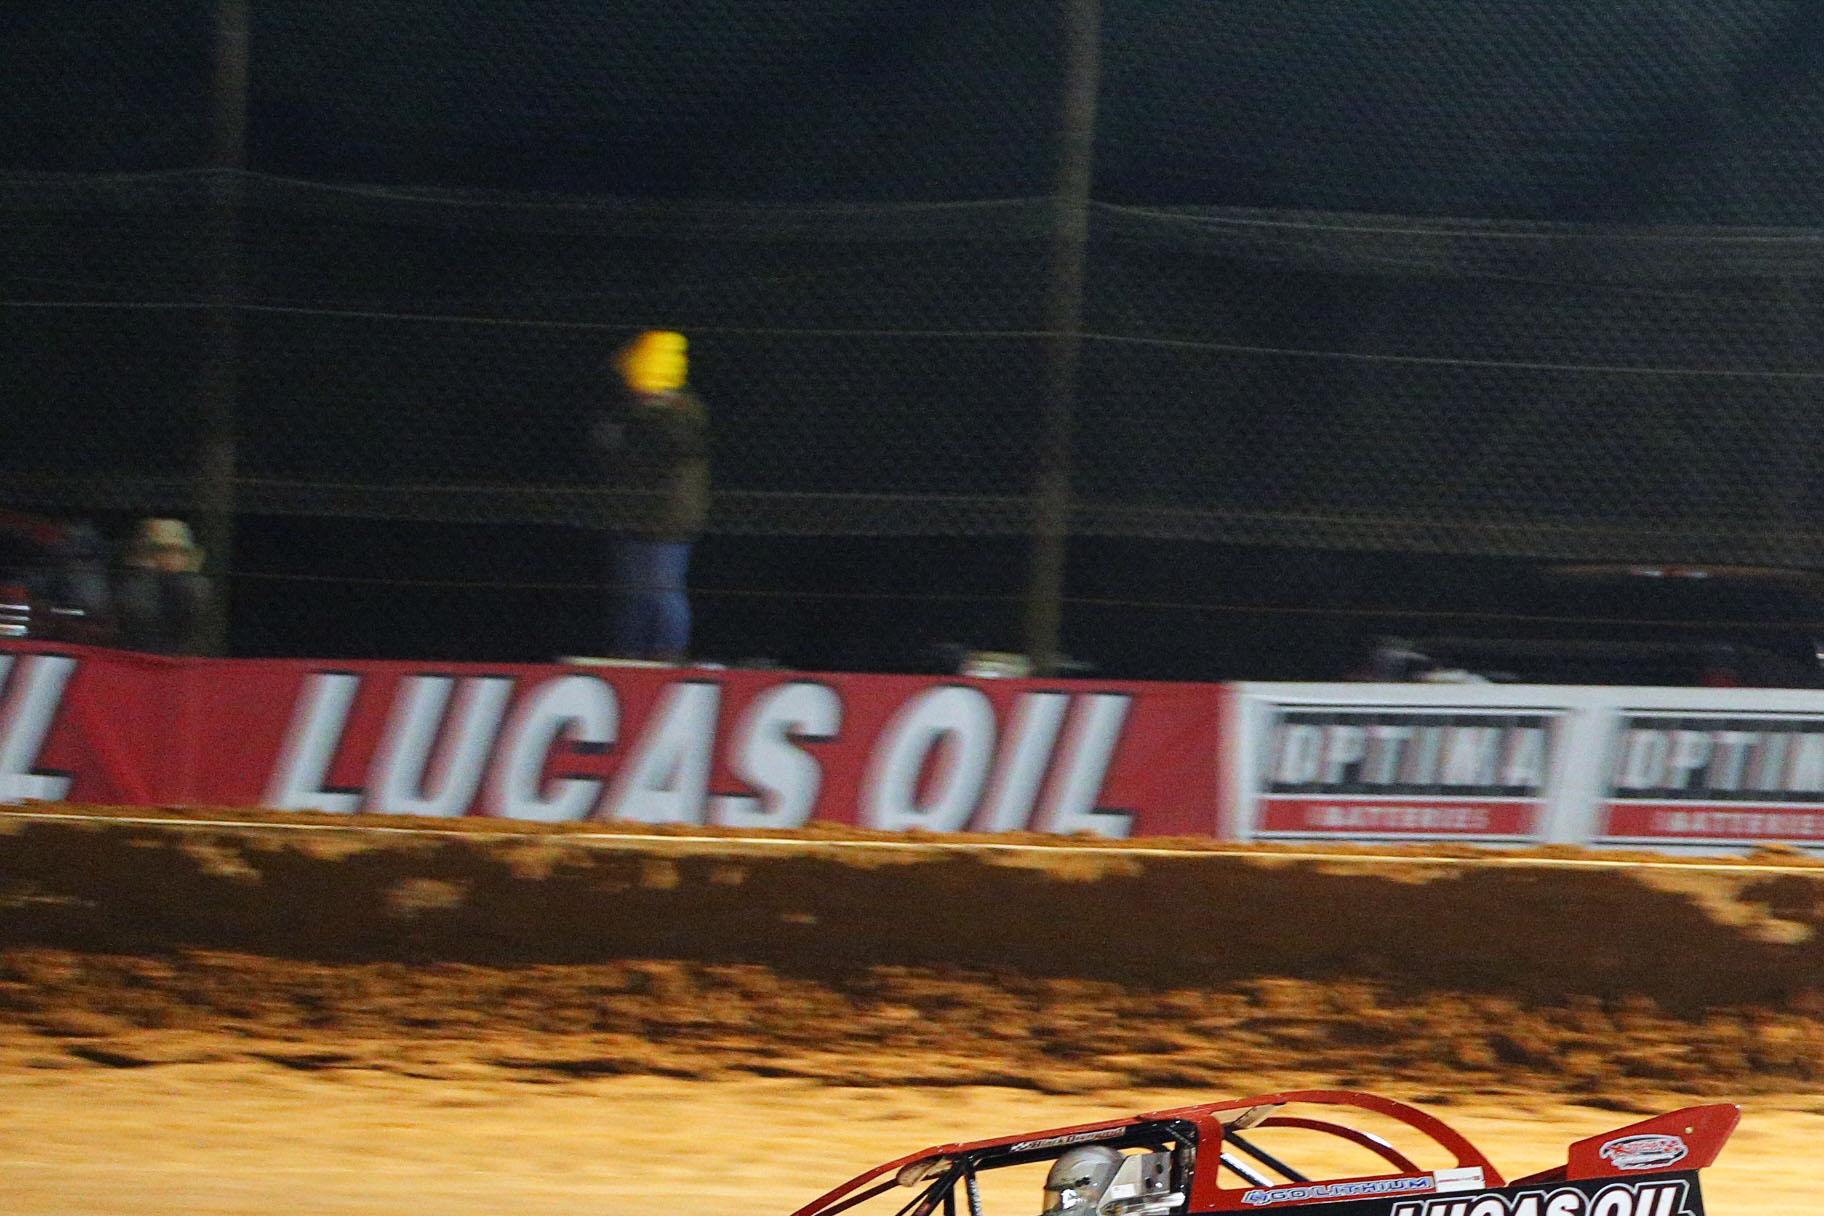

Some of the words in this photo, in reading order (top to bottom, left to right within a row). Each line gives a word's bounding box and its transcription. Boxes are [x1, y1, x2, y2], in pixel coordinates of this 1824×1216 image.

[264, 671, 842, 829] LUCAS
[859, 684, 1135, 839] OIL
[1276, 724, 1547, 787] OPTIMA
[1316, 1178, 1431, 1197] LITHIUM
